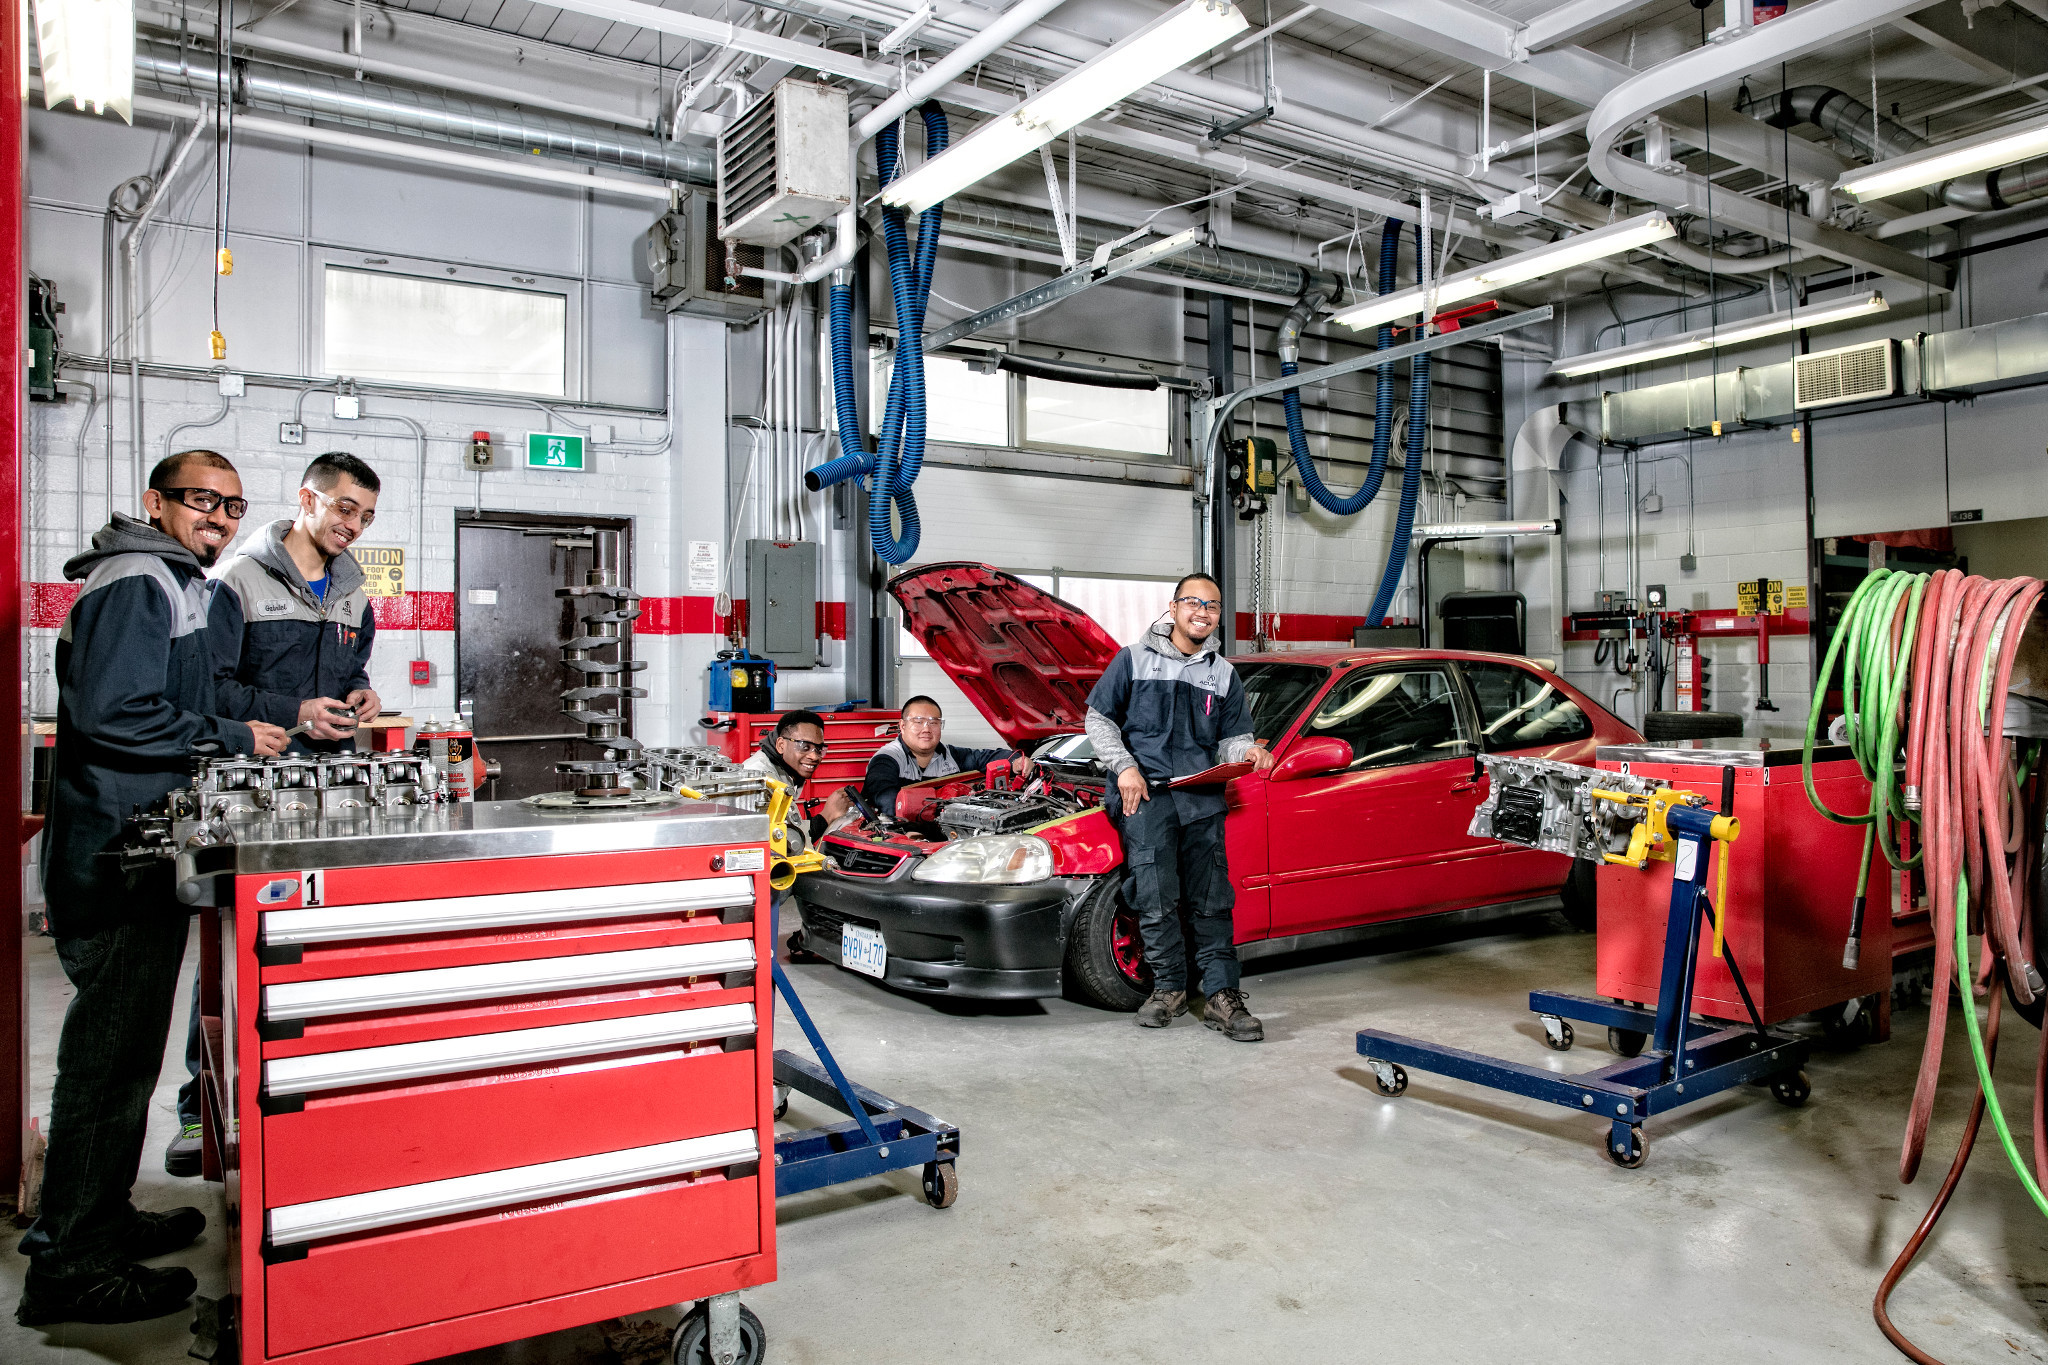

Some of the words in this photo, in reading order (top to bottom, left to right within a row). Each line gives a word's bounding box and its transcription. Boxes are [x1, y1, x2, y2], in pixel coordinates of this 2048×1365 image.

[1959, 512, 1973, 520] 138
[1425, 525, 1487, 534] HUNTER
[354, 549, 401, 565] UTION
[1739, 582, 1781, 595] CAUON
[265, 603, 287, 612] Gabriel
[1622, 762, 1629, 774] 2
[1764, 768, 1769, 785] 2
[1677, 844, 1694, 874] 2
[307, 873, 320, 906] 1
[868, 942, 884, 966] 170
